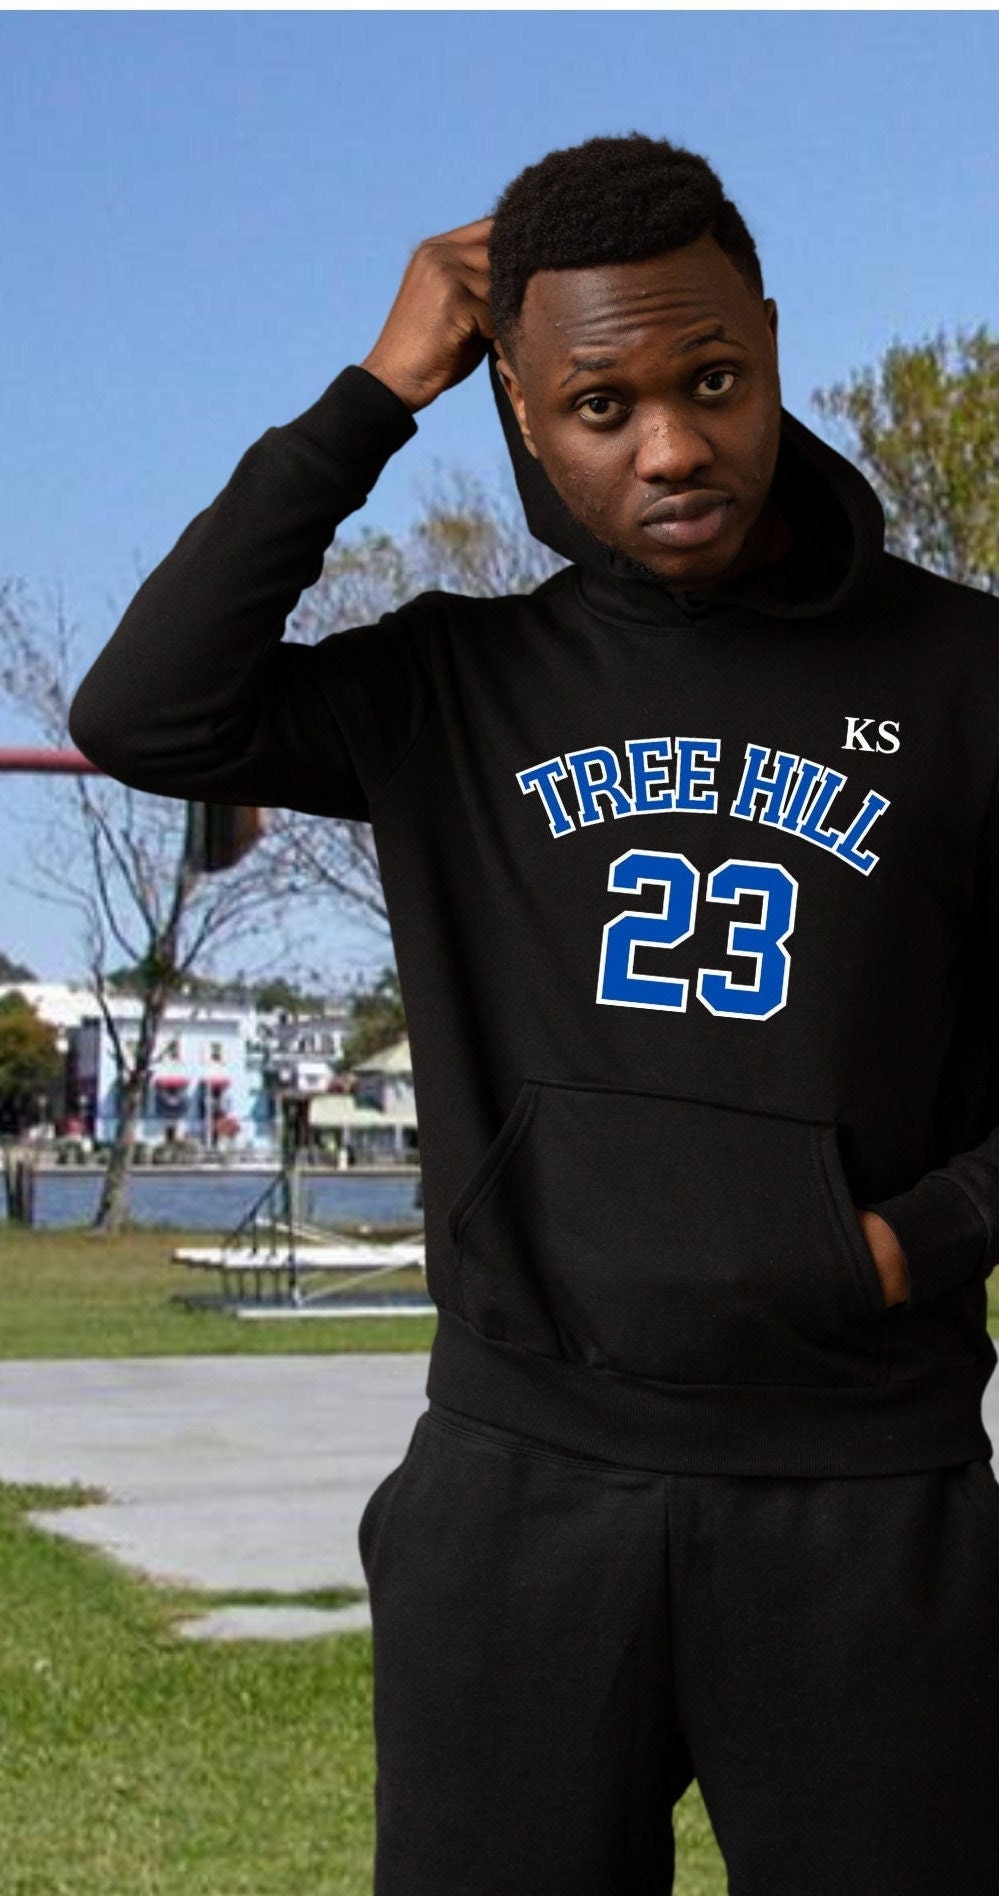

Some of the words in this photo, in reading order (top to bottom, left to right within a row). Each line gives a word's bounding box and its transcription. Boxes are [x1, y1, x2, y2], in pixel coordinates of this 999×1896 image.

[842, 717, 901, 755] KS
[515, 737, 721, 839] TREE
[730, 743, 891, 876] HILL
[596, 849, 799, 1021] 23
